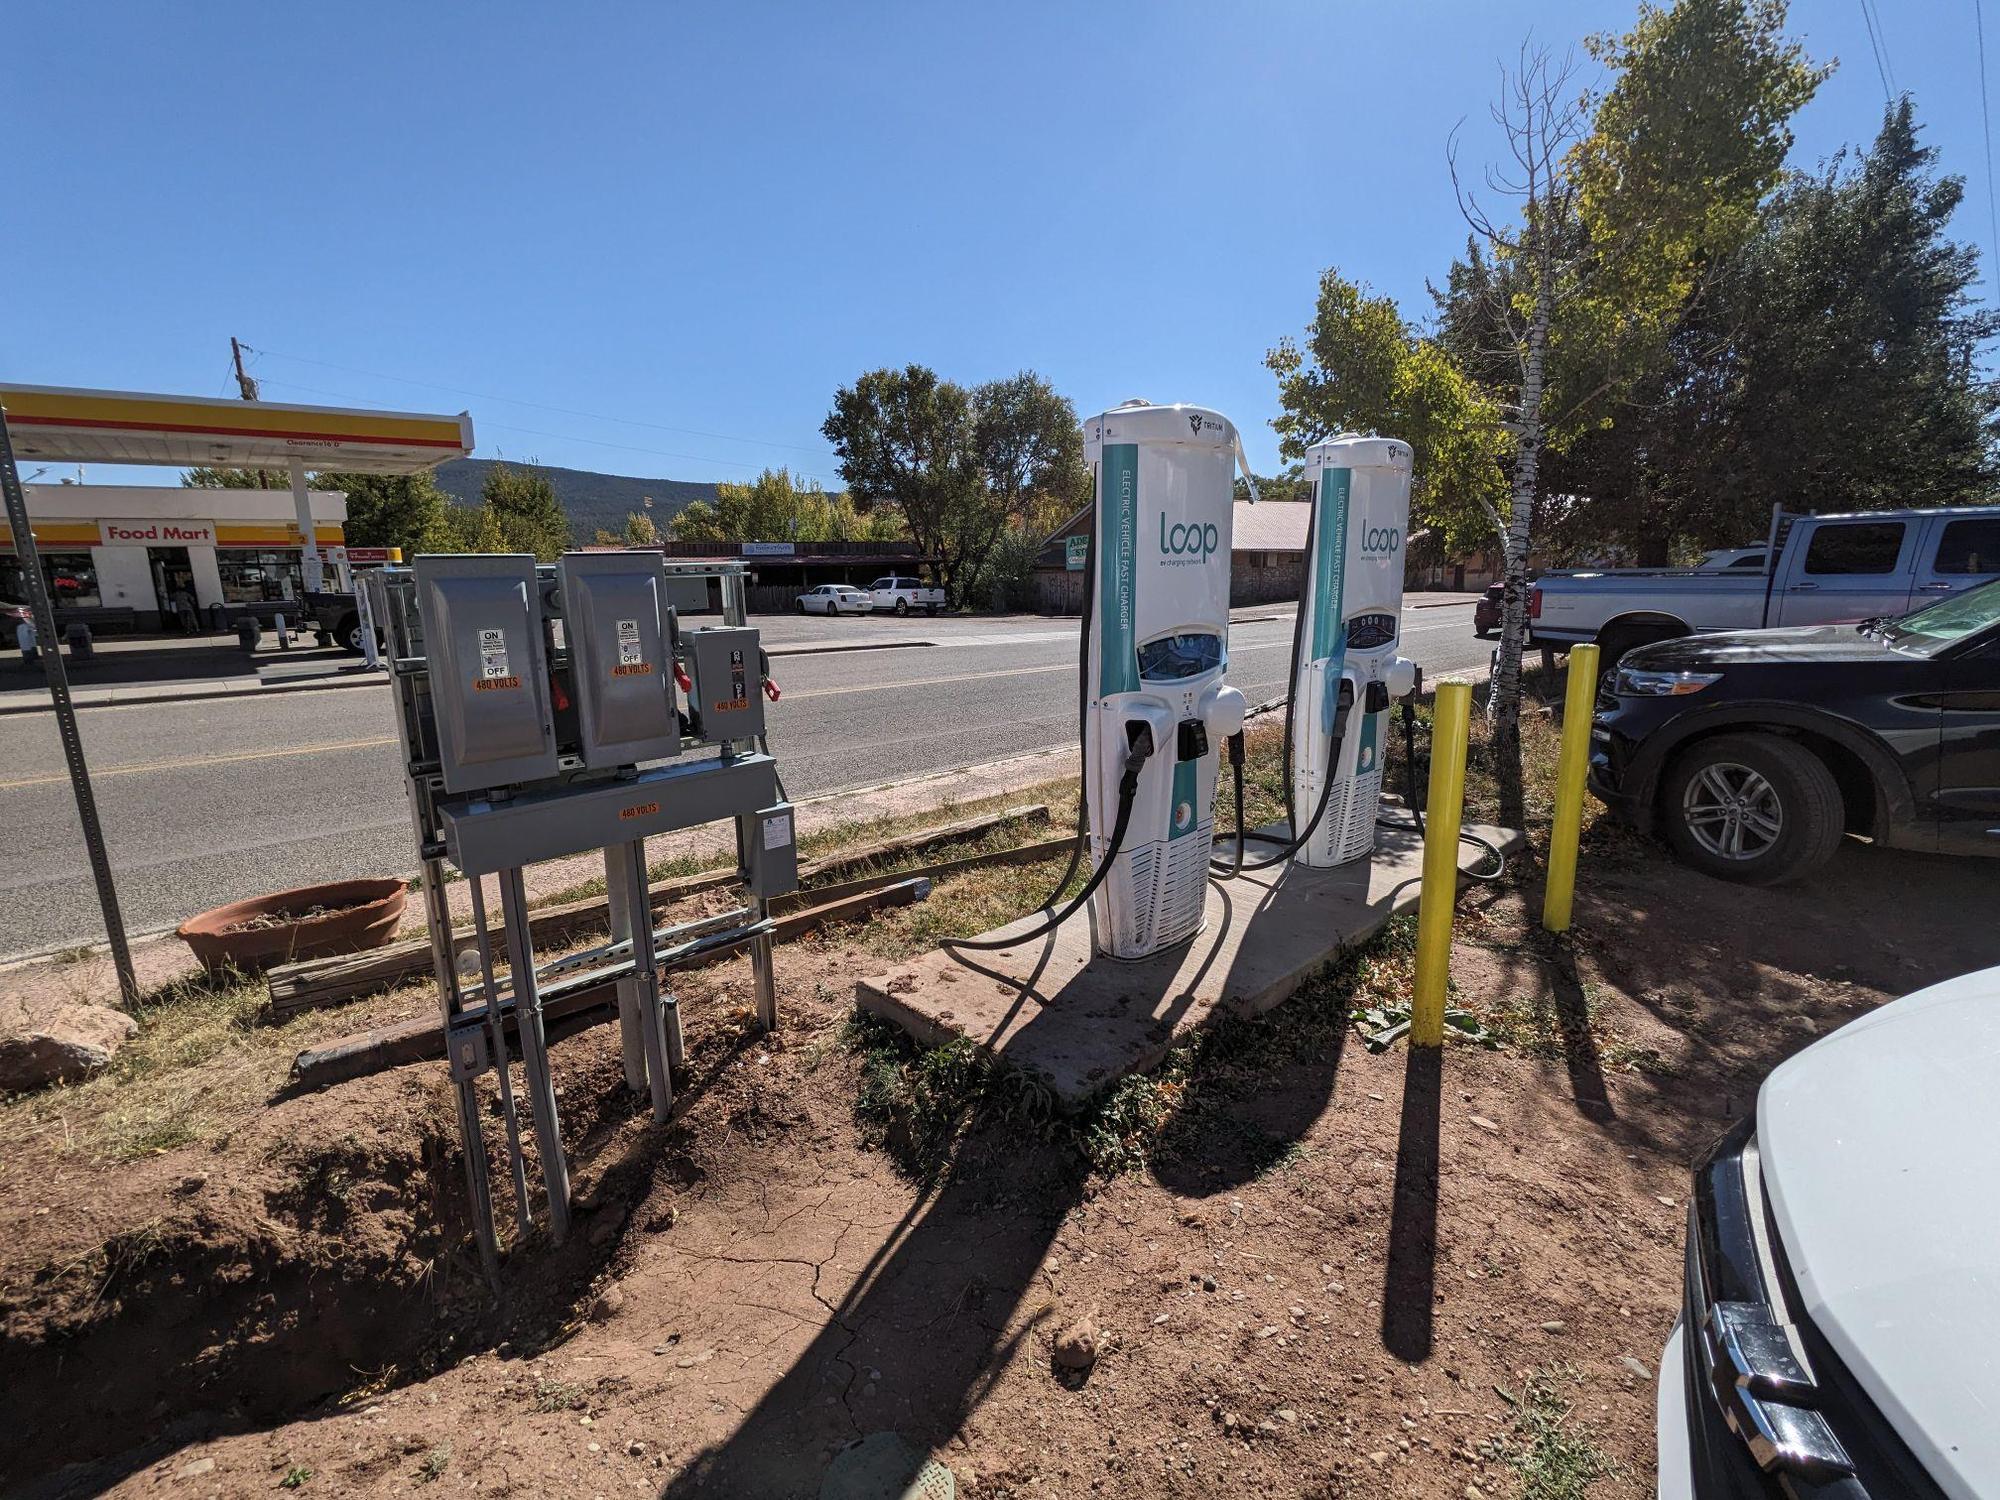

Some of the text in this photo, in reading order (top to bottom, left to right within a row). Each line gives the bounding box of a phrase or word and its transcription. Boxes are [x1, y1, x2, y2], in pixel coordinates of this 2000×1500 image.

[286, 439, 323, 447] Clearance
[1336, 487, 1345, 521] ELECTRIC
[107, 526, 210, 540] Food Mart
[1160, 511, 1218, 564] loop
[1361, 518, 1399, 559] loop
[1120, 470, 1131, 630] ELECTRIC VEHICLE FAST CHARGER
[1333, 555, 1341, 573] FAST
[622, 622, 634, 630] ON
[484, 631, 499, 640] ON
[623, 654, 639, 663] OFF
[487, 667, 505, 676] OFF
[614, 663, 649, 675] 480 VOLTS
[476, 676, 518, 691] 480 VOLTS
[730, 699, 747, 710] VOLTS
[622, 802, 657, 819] 480 VOLTS
